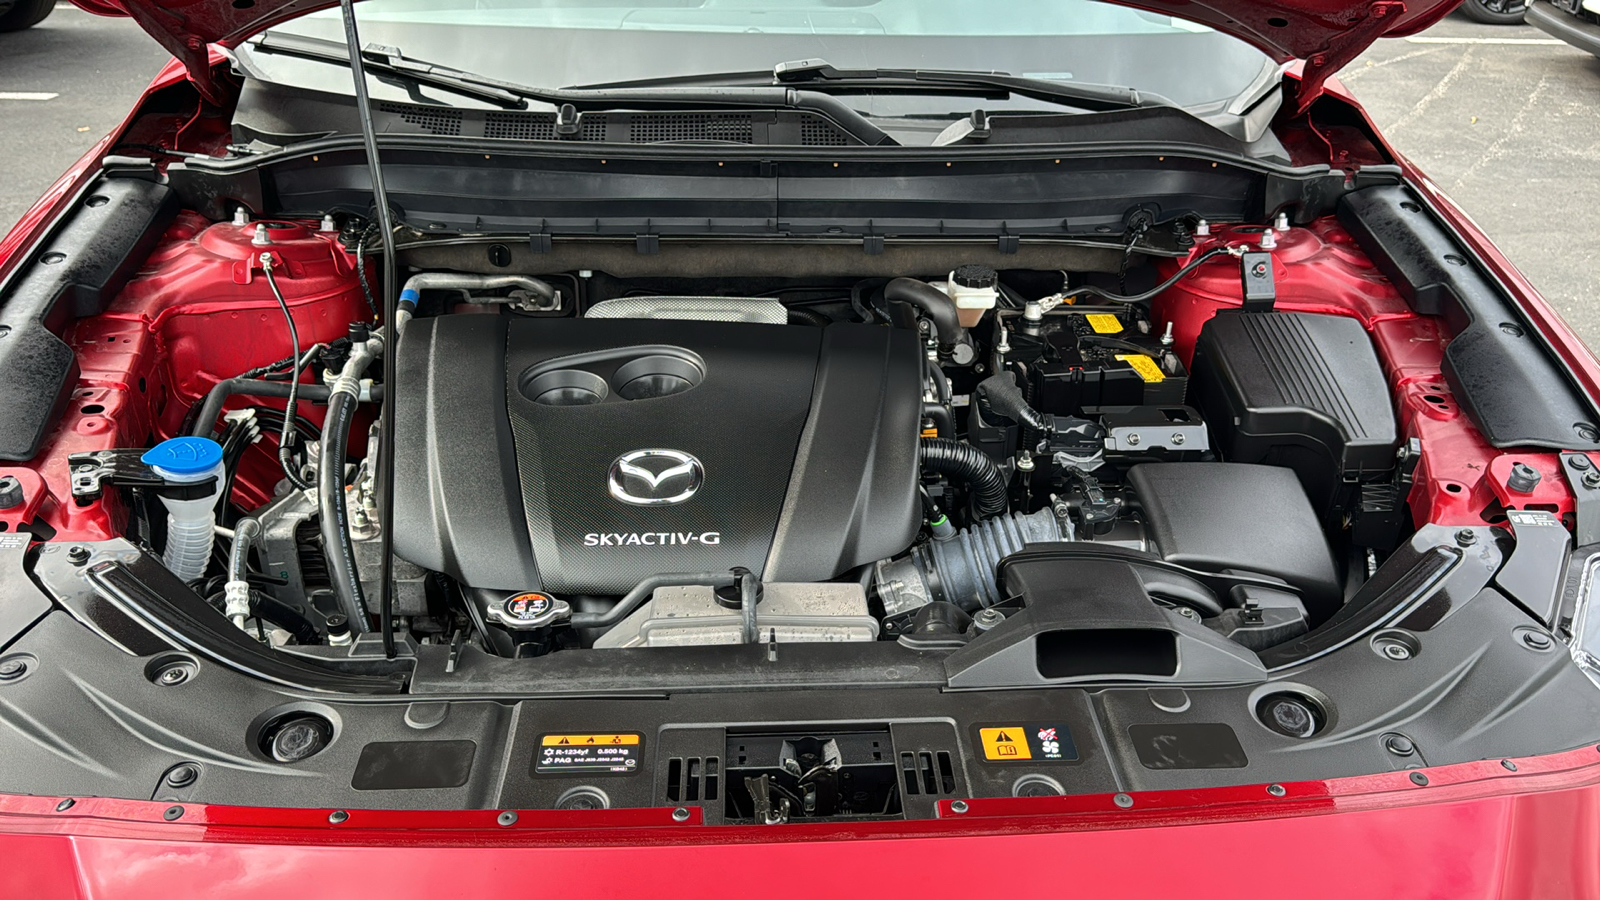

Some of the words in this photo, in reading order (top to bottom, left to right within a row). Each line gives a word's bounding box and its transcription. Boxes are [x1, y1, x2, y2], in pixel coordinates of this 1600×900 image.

[339, 526, 347, 548] SUCTION
[583, 531, 721, 547] SKYACTIV-G
[346, 559, 360, 600] Flexbarrier
[555, 748, 589, 756] R-1234yf
